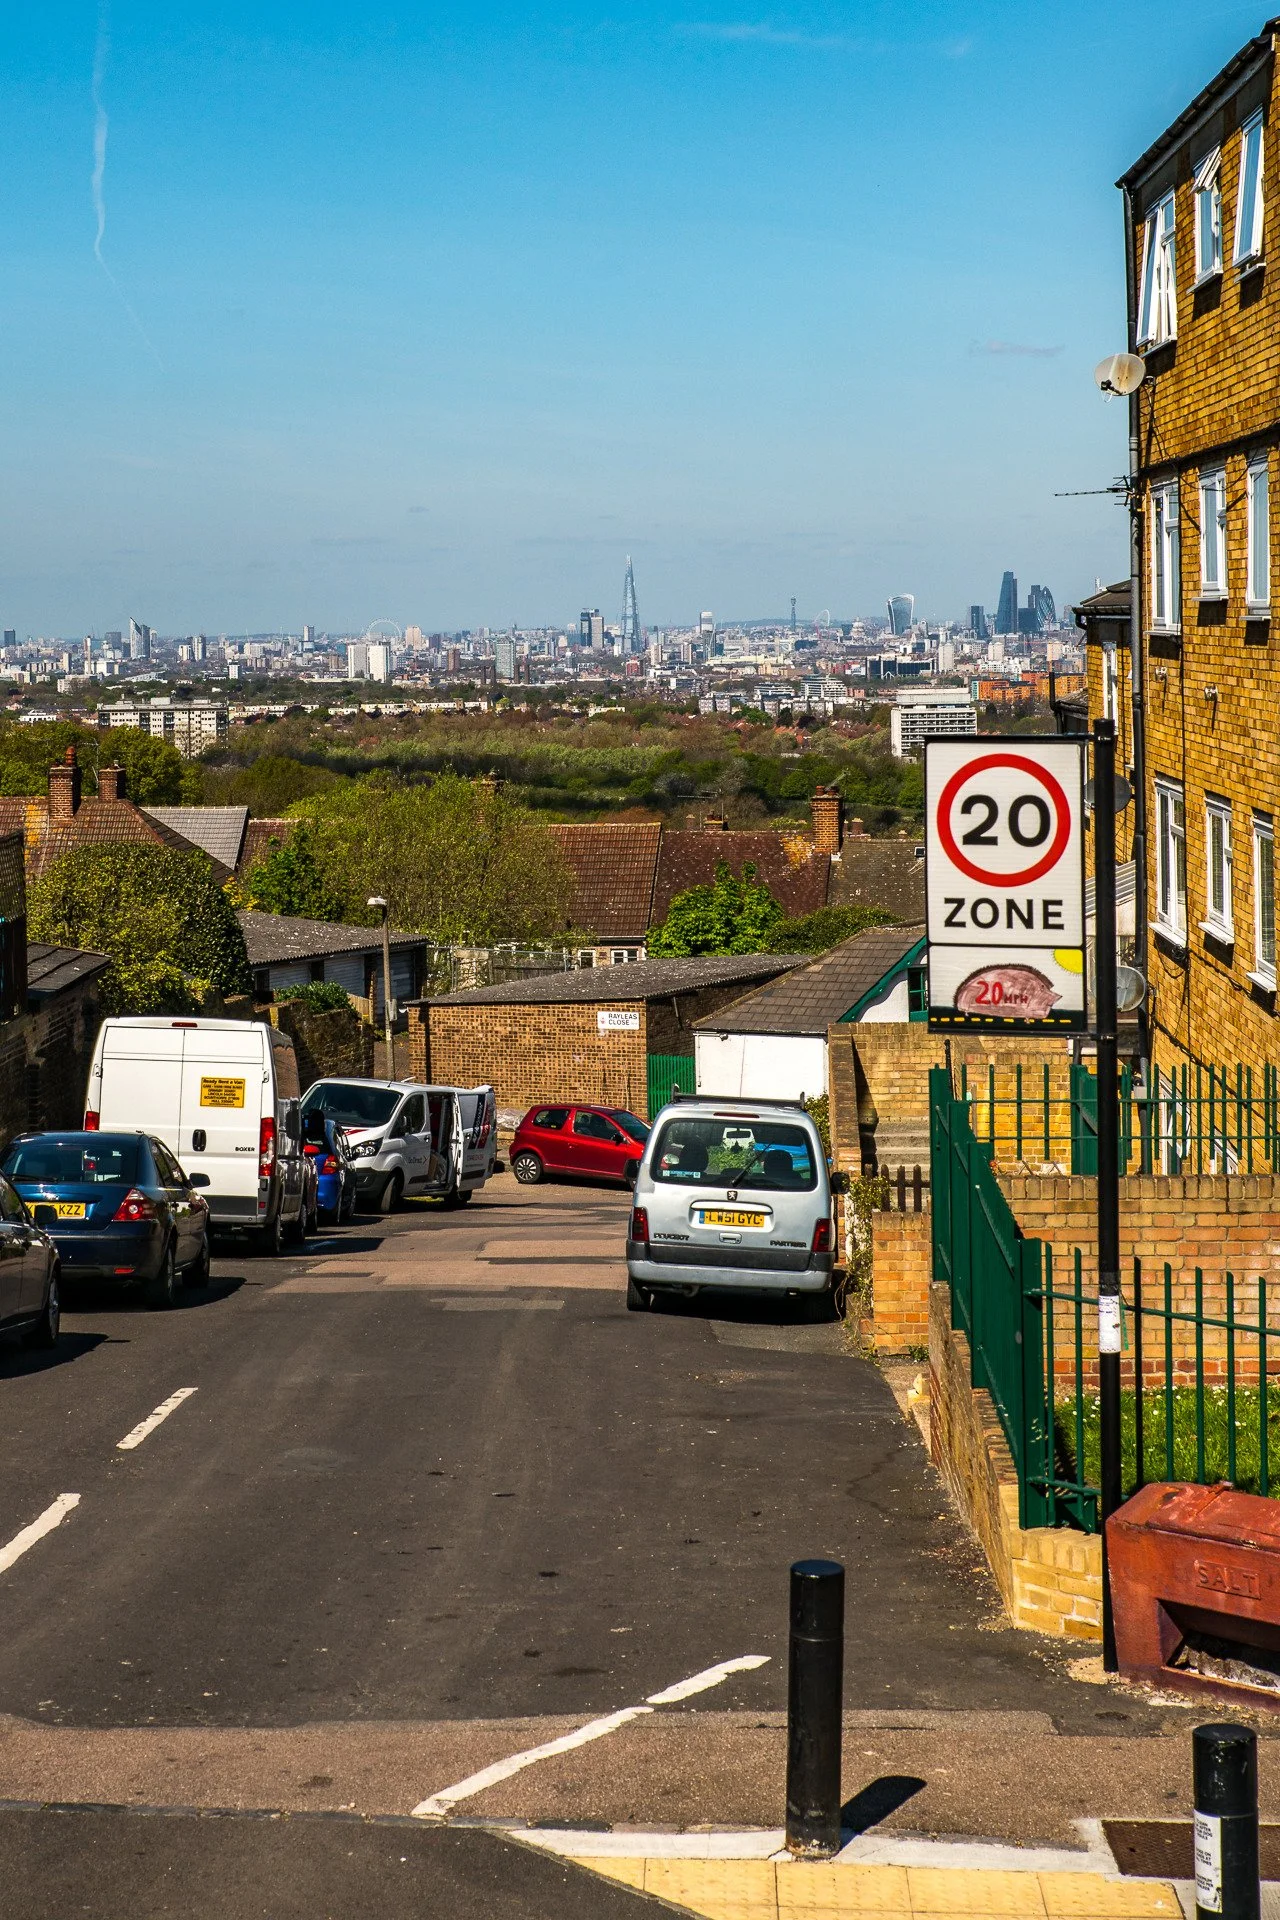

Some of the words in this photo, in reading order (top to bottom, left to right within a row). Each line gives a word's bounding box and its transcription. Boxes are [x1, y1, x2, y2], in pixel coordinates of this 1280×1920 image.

[960, 794, 1051, 847] 20
[944, 897, 1064, 930] ZONE
[975, 981, 1003, 1005] 20
[1003, 993, 1028, 1004] MPH
[59, 1205, 81, 1215] KZZ
[738, 1213, 761, 1225] GYC
[1199, 1564, 1257, 1593] SALT
